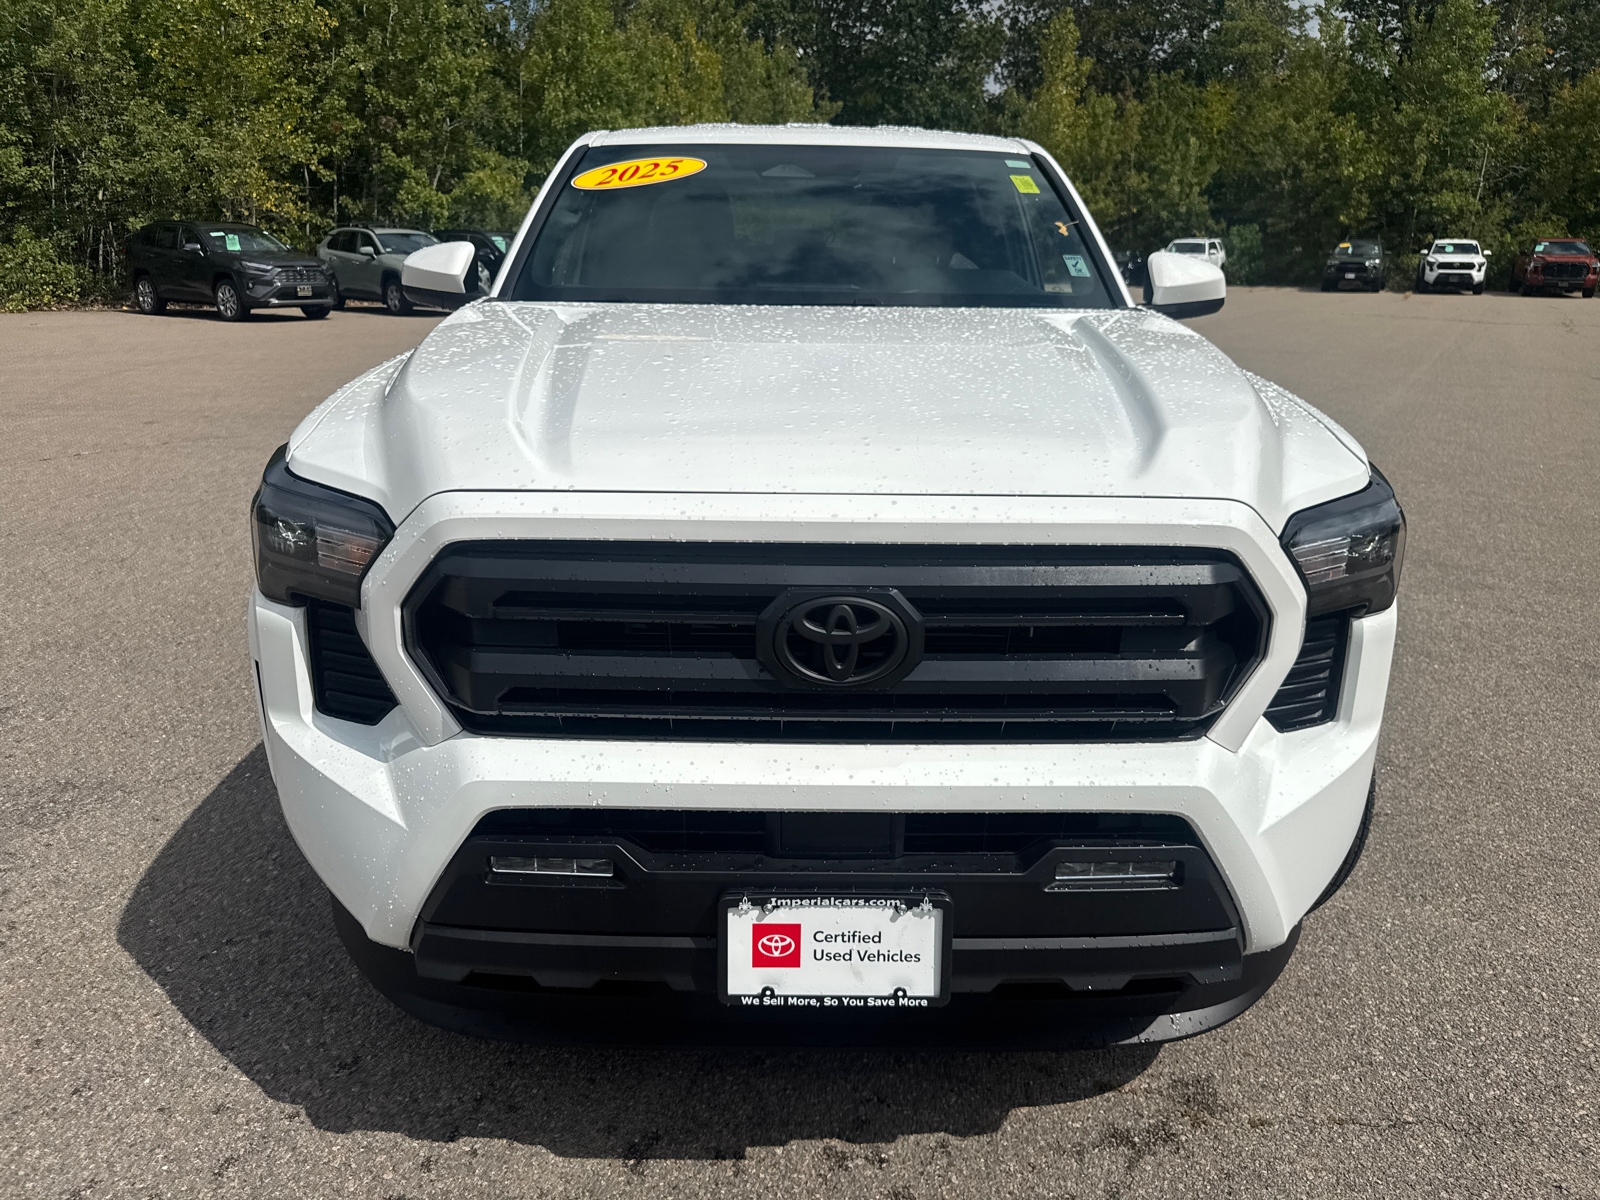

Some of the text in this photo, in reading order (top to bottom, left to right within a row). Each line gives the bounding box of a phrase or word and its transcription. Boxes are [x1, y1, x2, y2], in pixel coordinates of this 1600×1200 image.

[594, 160, 684, 186] 2025
[770, 897, 901, 908] Imperialcars.com
[813, 930, 882, 944] Certified
[813, 949, 921, 963] Used Vehicles
[741, 996, 928, 1007] We Sell More, So You Save More
